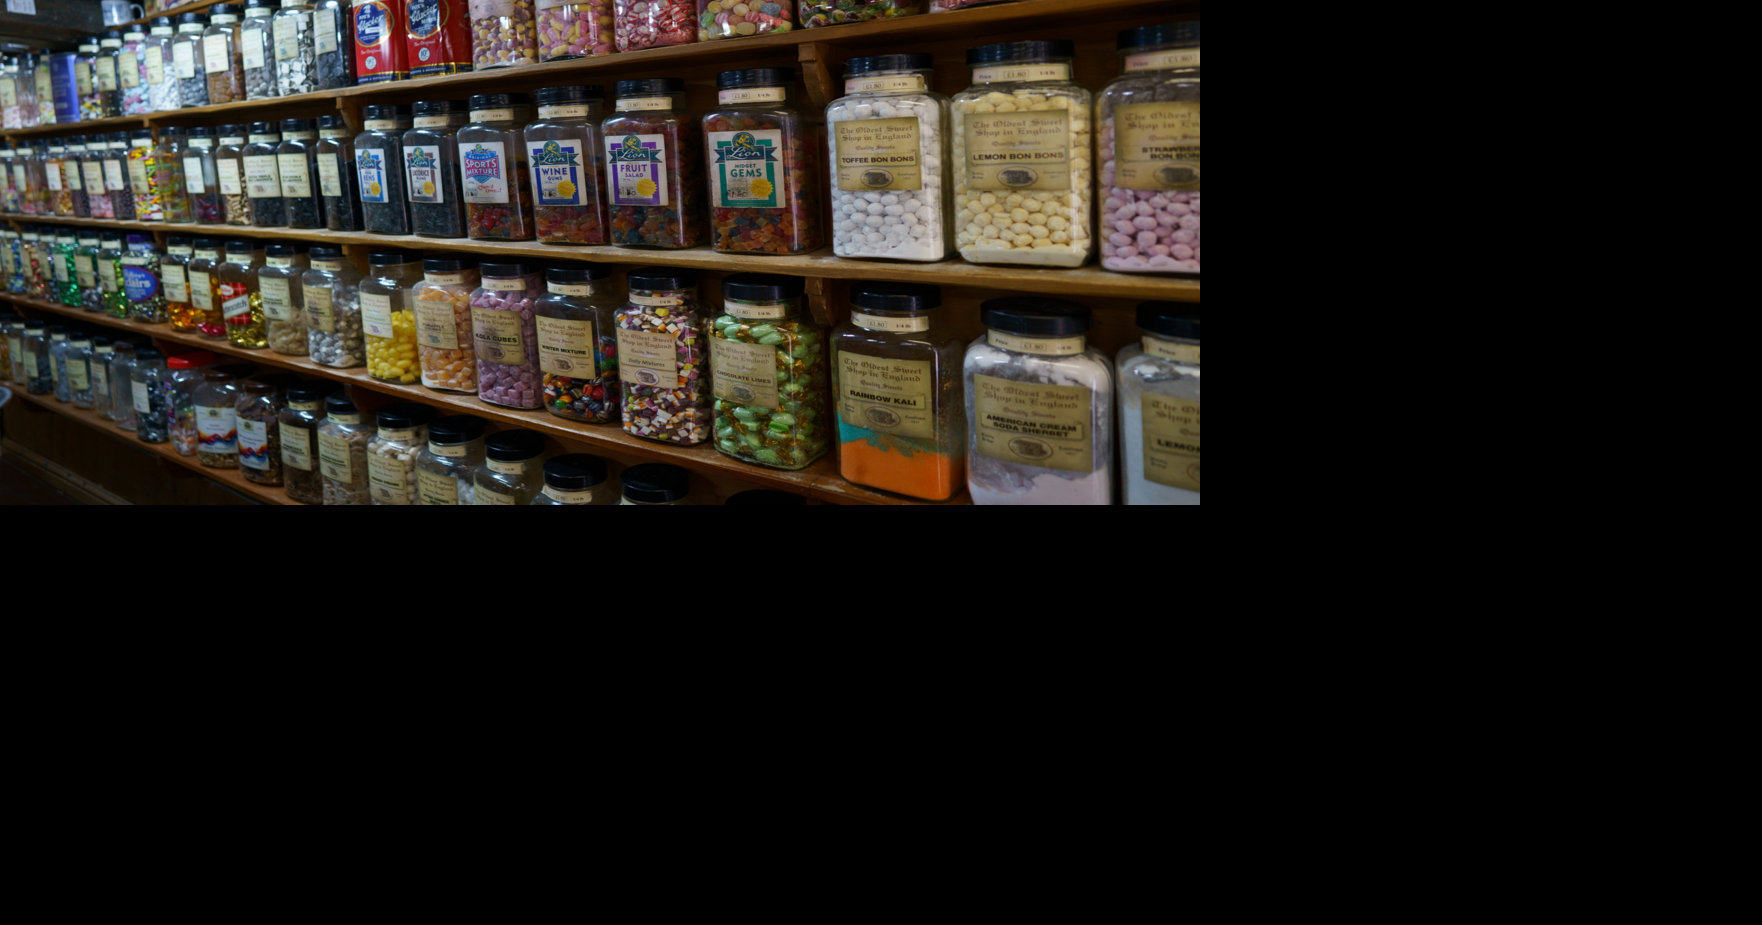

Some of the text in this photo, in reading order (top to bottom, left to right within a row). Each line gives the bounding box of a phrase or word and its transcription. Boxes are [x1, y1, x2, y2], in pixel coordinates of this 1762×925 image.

[410, 4, 438, 25] Glacier
[358, 14, 384, 34] Glacier
[1150, 111, 1191, 120] Oldest
[1127, 121, 1159, 130] Shop
[842, 134, 862, 142] Shop
[875, 133, 911, 141] England
[975, 128, 1000, 137] Shop
[1016, 127, 1061, 136] England
[540, 153, 566, 164] Lion
[618, 149, 646, 160] Lion
[726, 147, 761, 160] Lion
[412, 158, 428, 167] Lion
[466, 159, 497, 168] SPORTS
[466, 168, 497, 176] MIXTURE
[541, 168, 568, 176] WINE
[620, 164, 648, 173] FRUIT
[730, 168, 762, 177] GEMS
[476, 333, 491, 341] KOLA
[621, 338, 636, 346] Shop
[645, 341, 672, 349] England
[716, 351, 730, 359] Shop
[740, 355, 770, 365] England
[726, 347, 746, 355] Oldest
[749, 349, 770, 358] Sweet
[844, 358, 921, 374] The Oldest Sweet
[716, 370, 750, 382] CHOCOLATE
[845, 365, 867, 376] Shop
[880, 372, 920, 382] England
[860, 379, 880, 388] Quality
[982, 382, 1079, 401] The Oldest Sweet
[850, 390, 916, 406] RAINBOW KALI
[982, 390, 1012, 403] Shop
[1029, 396, 1078, 409] England
[1152, 400, 1177, 412] The
[1002, 406, 1056, 419] Quality Sweets
[1155, 410, 1191, 424] Shop
[986, 414, 1076, 432] AMERICAN CREAM
[993, 422, 1069, 437] SODA SHERBET
